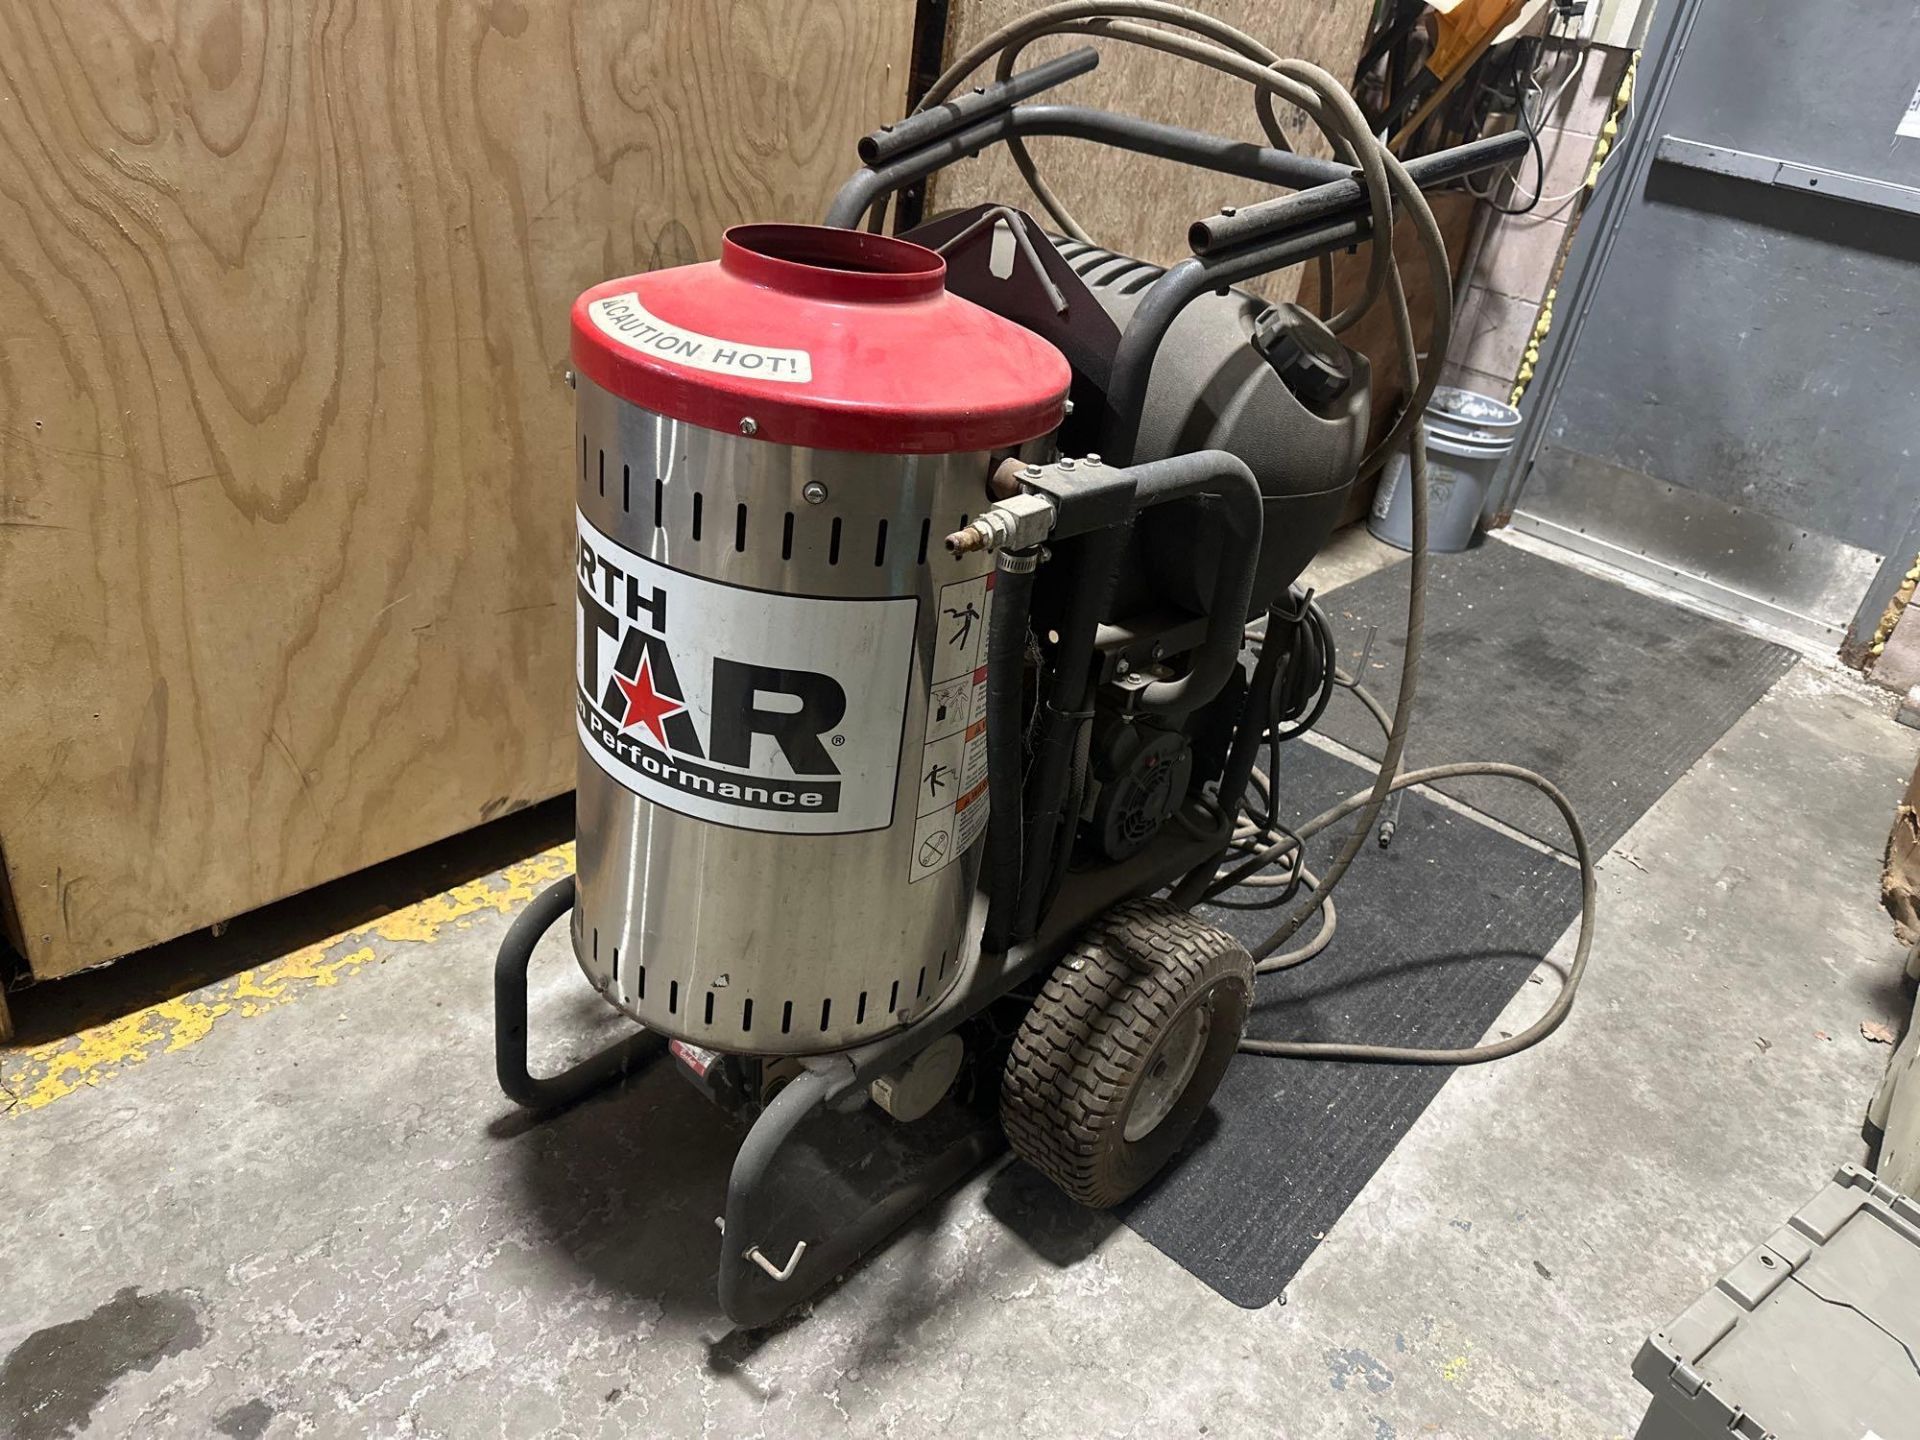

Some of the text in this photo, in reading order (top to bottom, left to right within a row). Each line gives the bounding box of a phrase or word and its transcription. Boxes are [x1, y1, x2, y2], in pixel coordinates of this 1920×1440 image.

[606, 305, 797, 374] CAUTION HOT!
[577, 525, 667, 634] RTH
[590, 711, 823, 807] Performance
